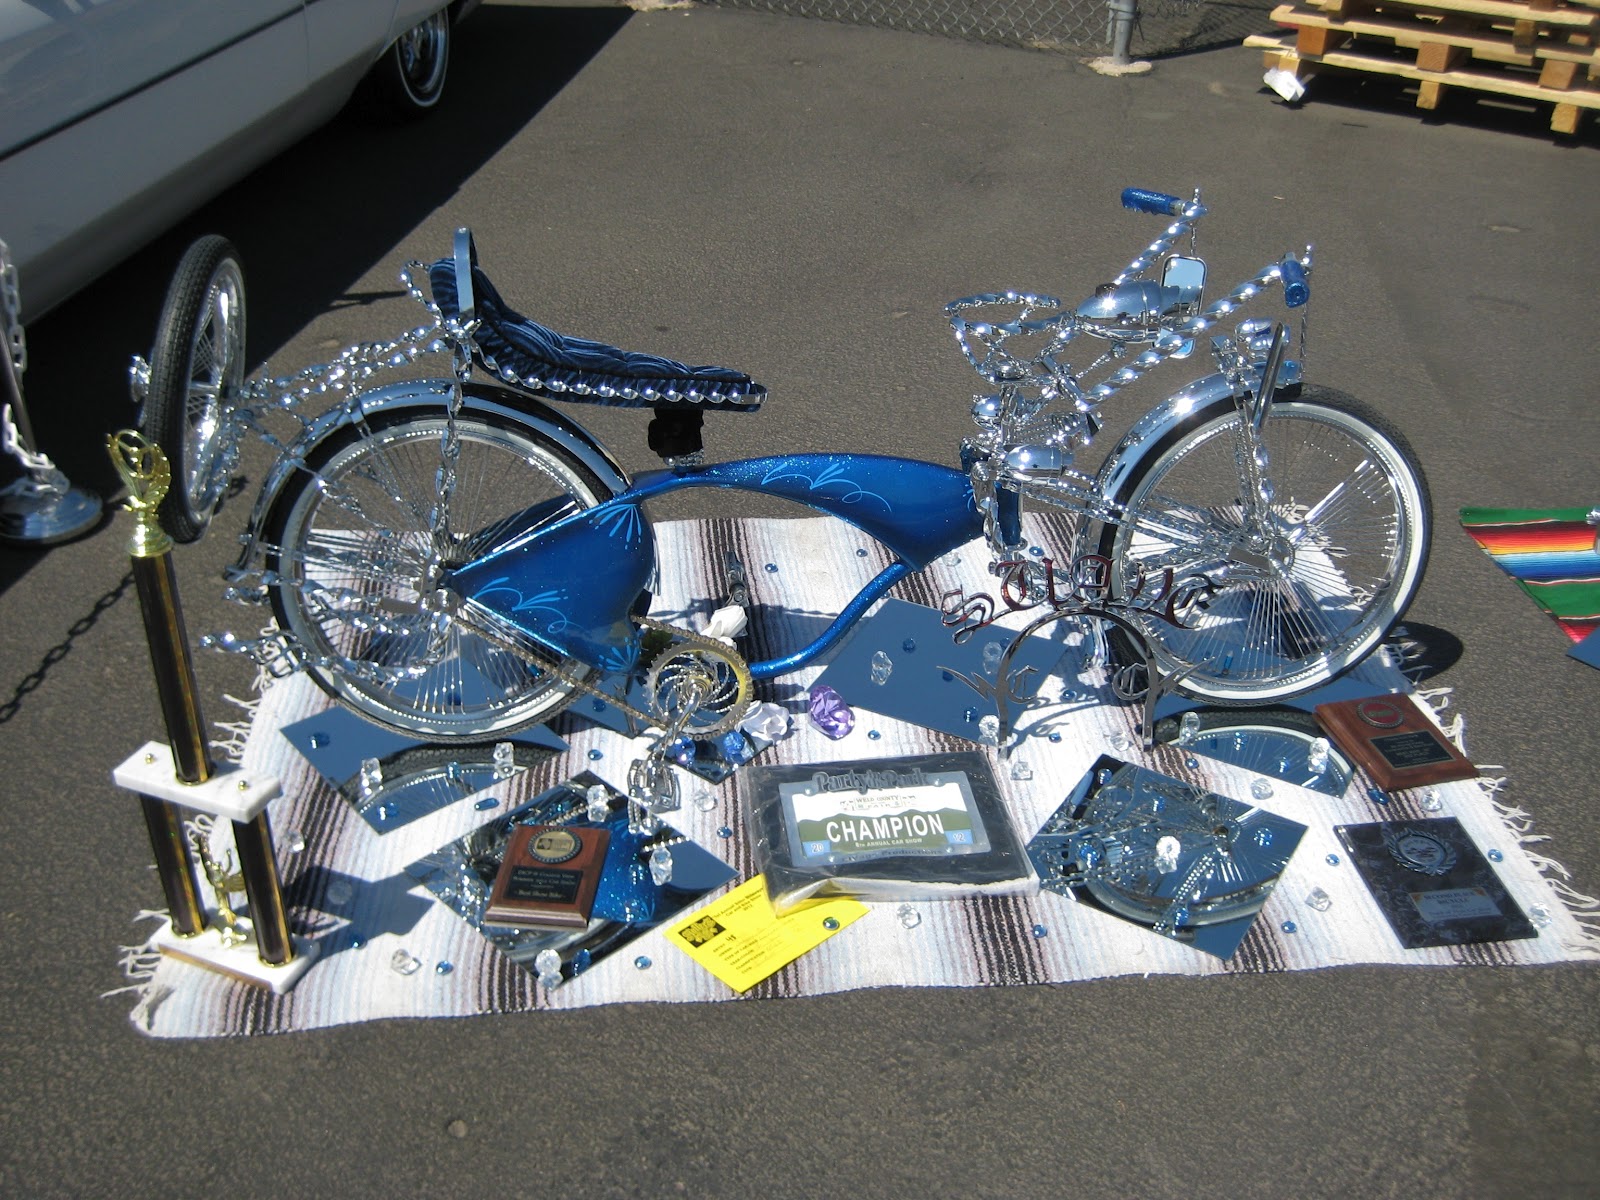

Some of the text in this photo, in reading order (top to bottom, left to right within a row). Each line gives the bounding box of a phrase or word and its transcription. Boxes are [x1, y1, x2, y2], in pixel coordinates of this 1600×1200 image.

[826, 814, 945, 843] CHAMPION
[952, 832, 967, 843] 12
[810, 842, 825, 854] 20
